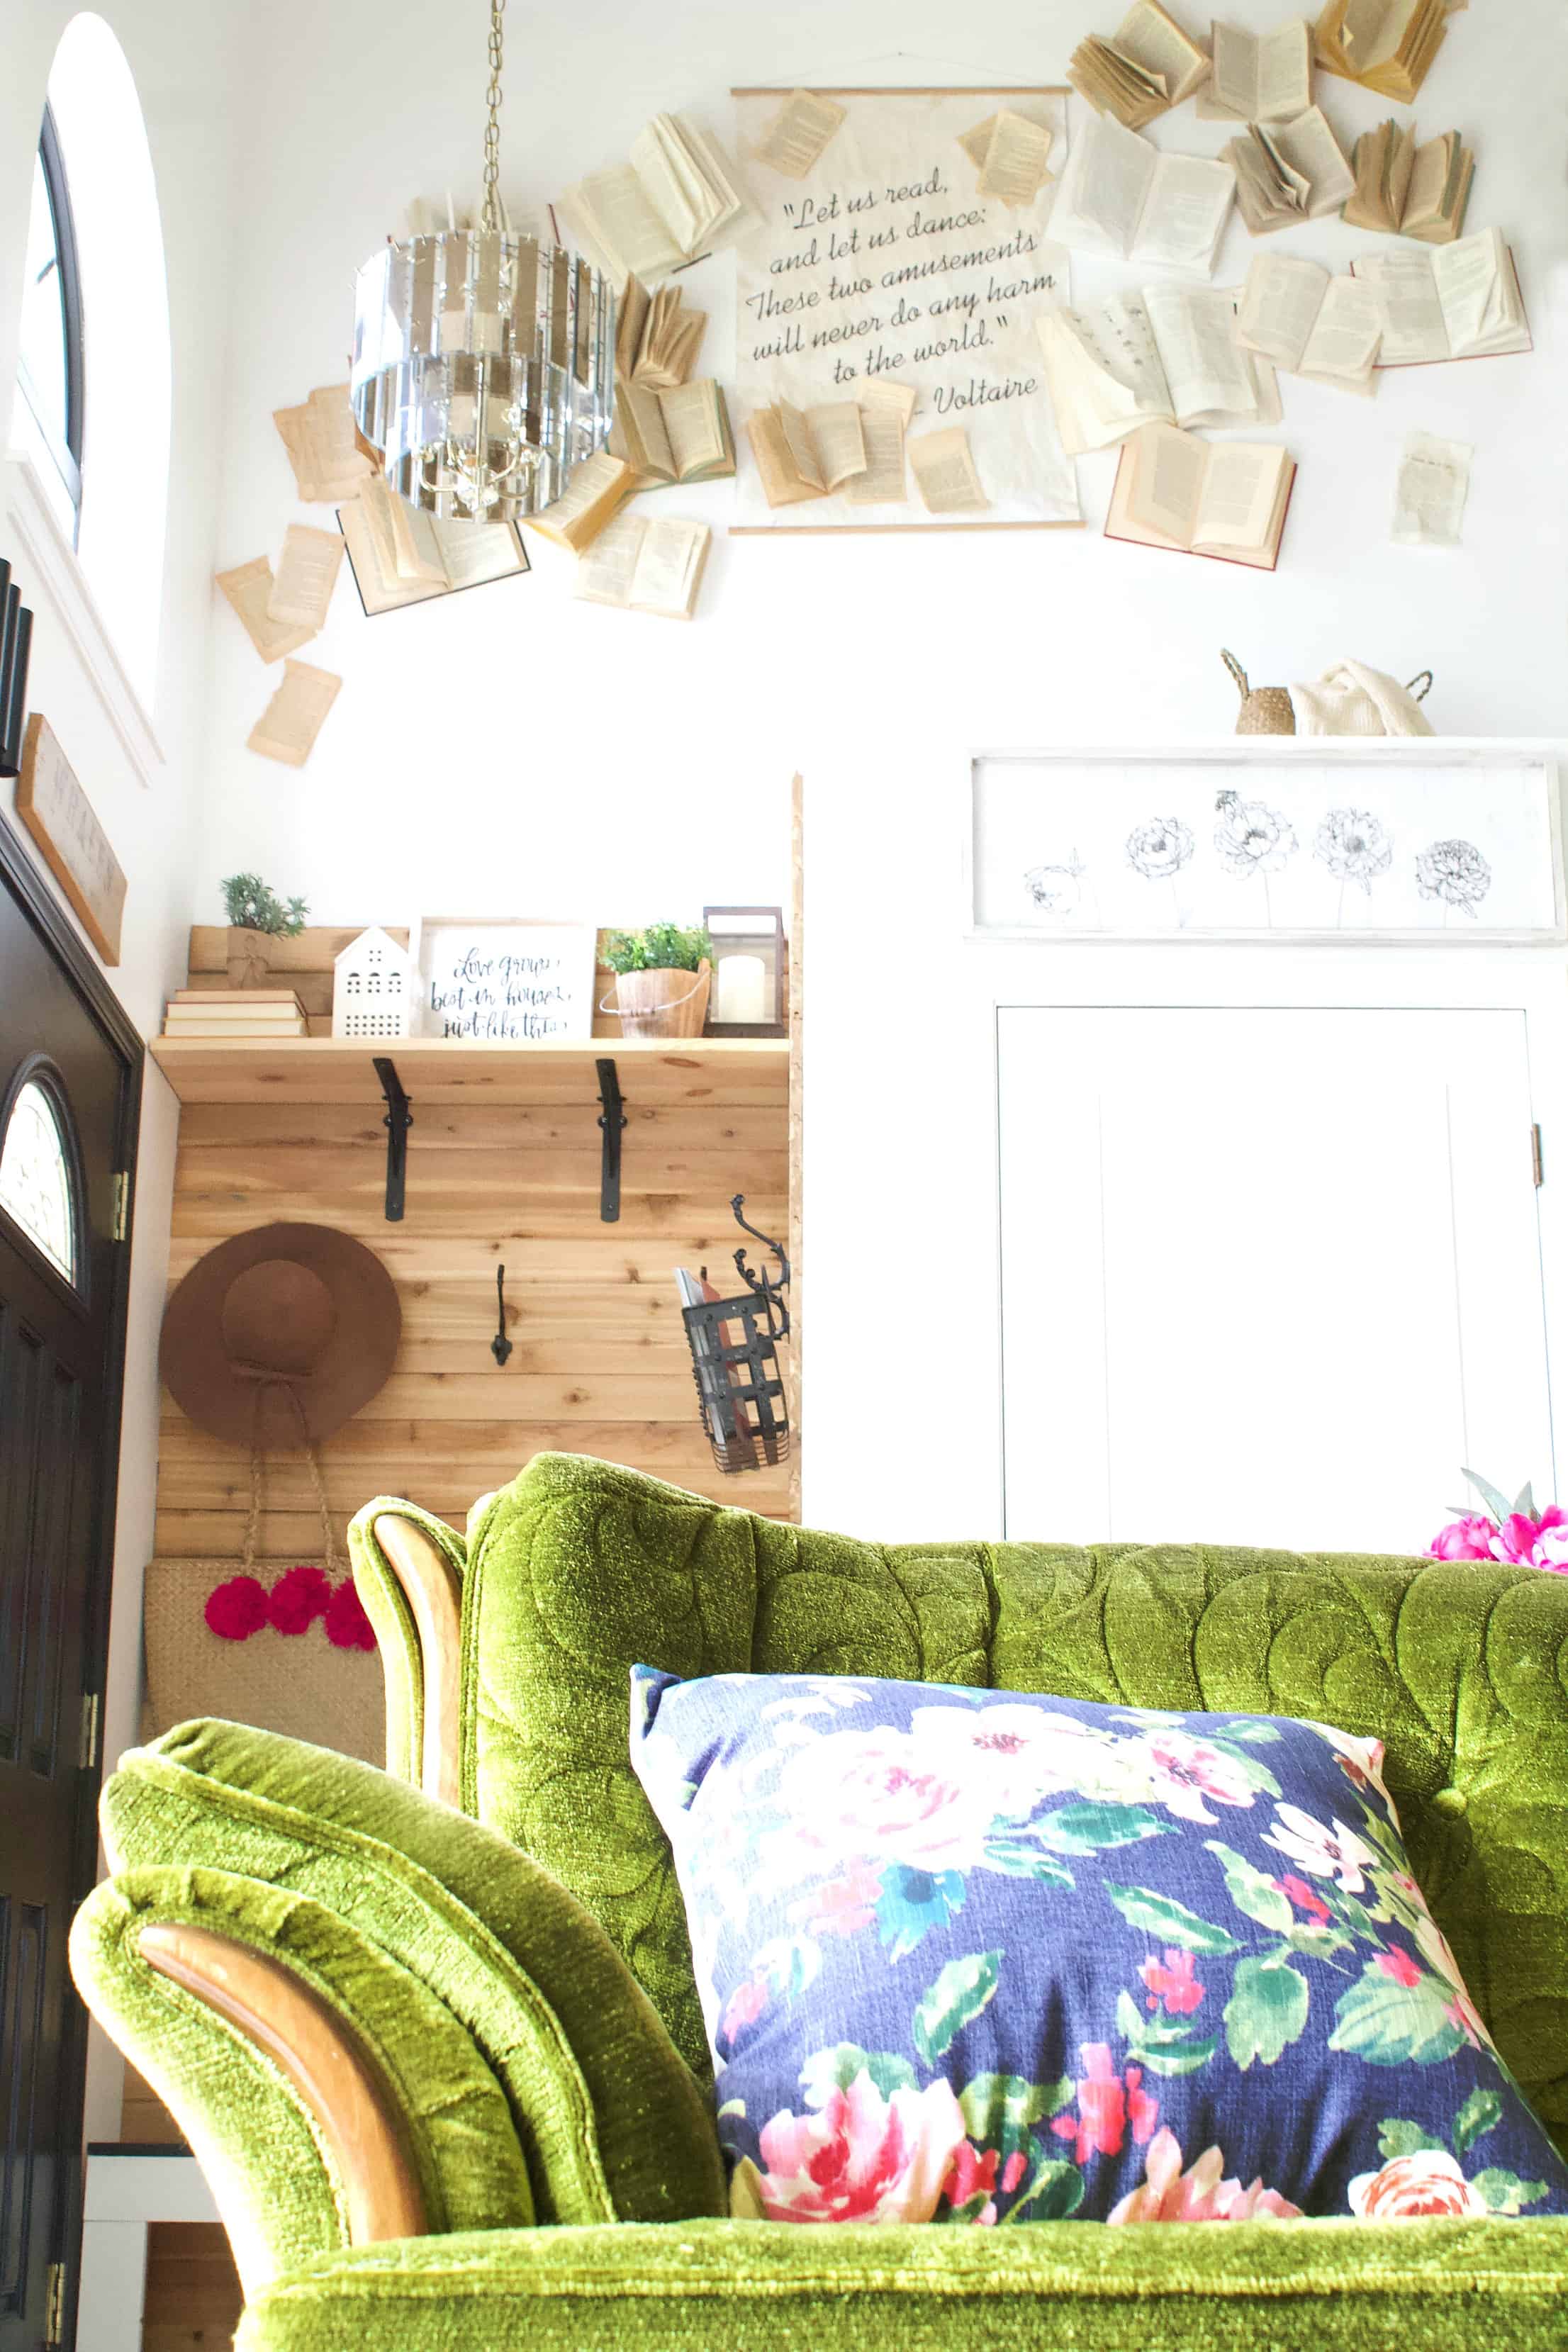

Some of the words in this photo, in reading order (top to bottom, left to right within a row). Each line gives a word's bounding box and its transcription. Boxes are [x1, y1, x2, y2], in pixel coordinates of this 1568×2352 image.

[783, 194, 841, 229] "Let
[846, 191, 878, 214] us
[885, 167, 948, 203] read,
[770, 237, 821, 274] and
[828, 228, 861, 260] let
[868, 227, 899, 250] us
[907, 208, 986, 238] dance:
[746, 290, 821, 320] These
[828, 276, 873, 301] two
[881, 230, 1038, 288] amusements
[753, 324, 805, 361] will
[811, 317, 883, 347] never
[891, 298, 922, 327] do
[929, 292, 980, 318] any
[986, 274, 1057, 303] harm
[834, 357, 858, 383] to
[866, 345, 906, 375] the
[934, 378, 1039, 414] Voltaire
[454, 947, 493, 984] Love
[431, 982, 466, 1011] best
